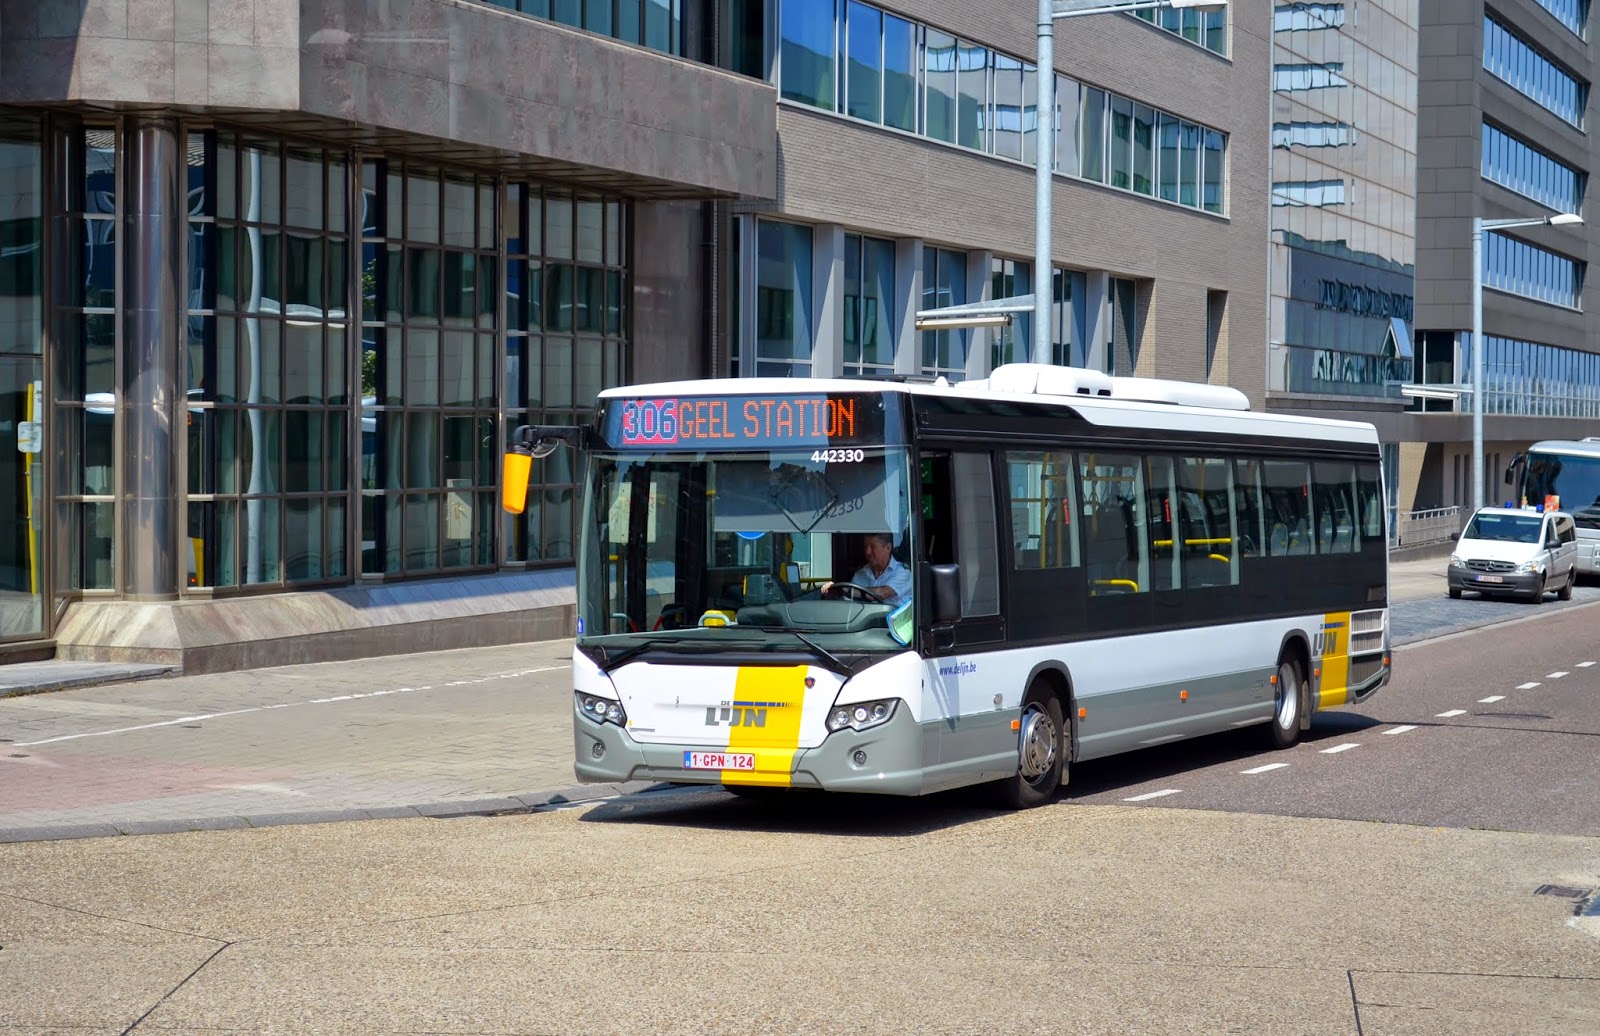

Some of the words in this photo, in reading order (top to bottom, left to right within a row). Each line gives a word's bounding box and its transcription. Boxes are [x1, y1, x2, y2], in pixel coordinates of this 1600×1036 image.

[623, 400, 677, 440] 306
[679, 401, 735, 438] GEEL
[743, 398, 854, 438] STATION
[811, 449, 864, 463] 442330
[705, 707, 767, 728] LIJN
